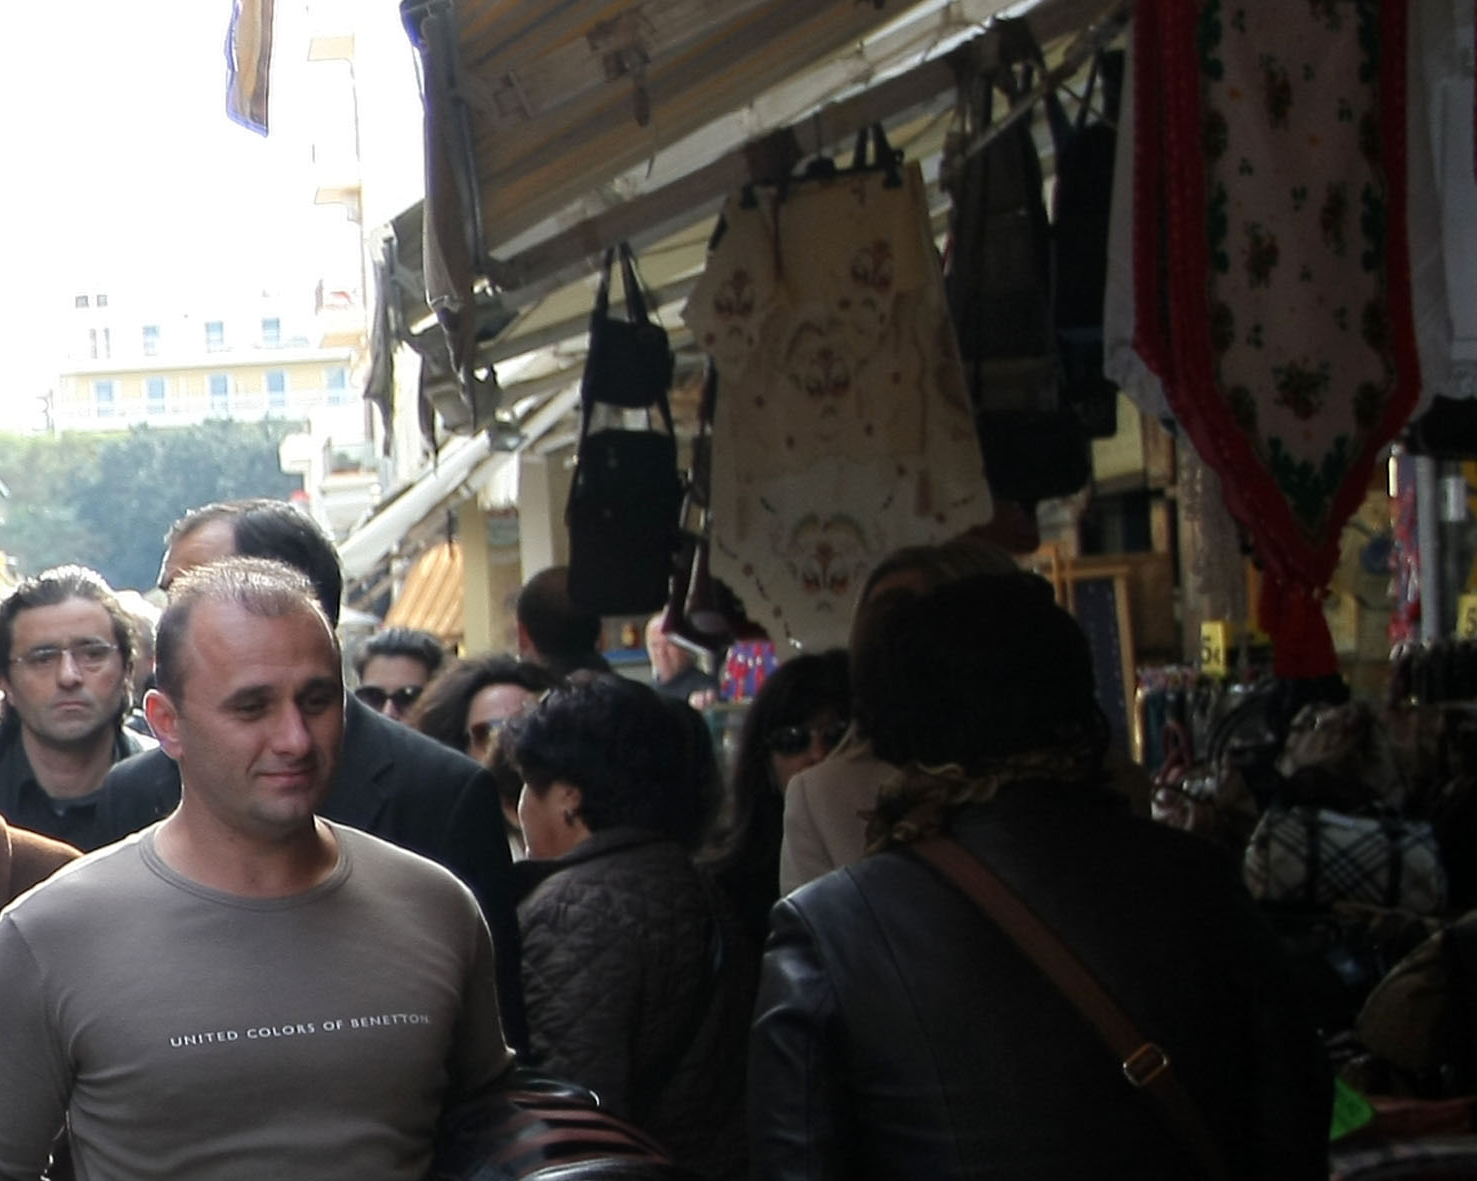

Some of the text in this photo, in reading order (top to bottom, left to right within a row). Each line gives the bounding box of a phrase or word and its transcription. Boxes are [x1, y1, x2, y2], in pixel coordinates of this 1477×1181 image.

[170, 1013, 430, 1047] UNITED COLORS OF BENETTON
